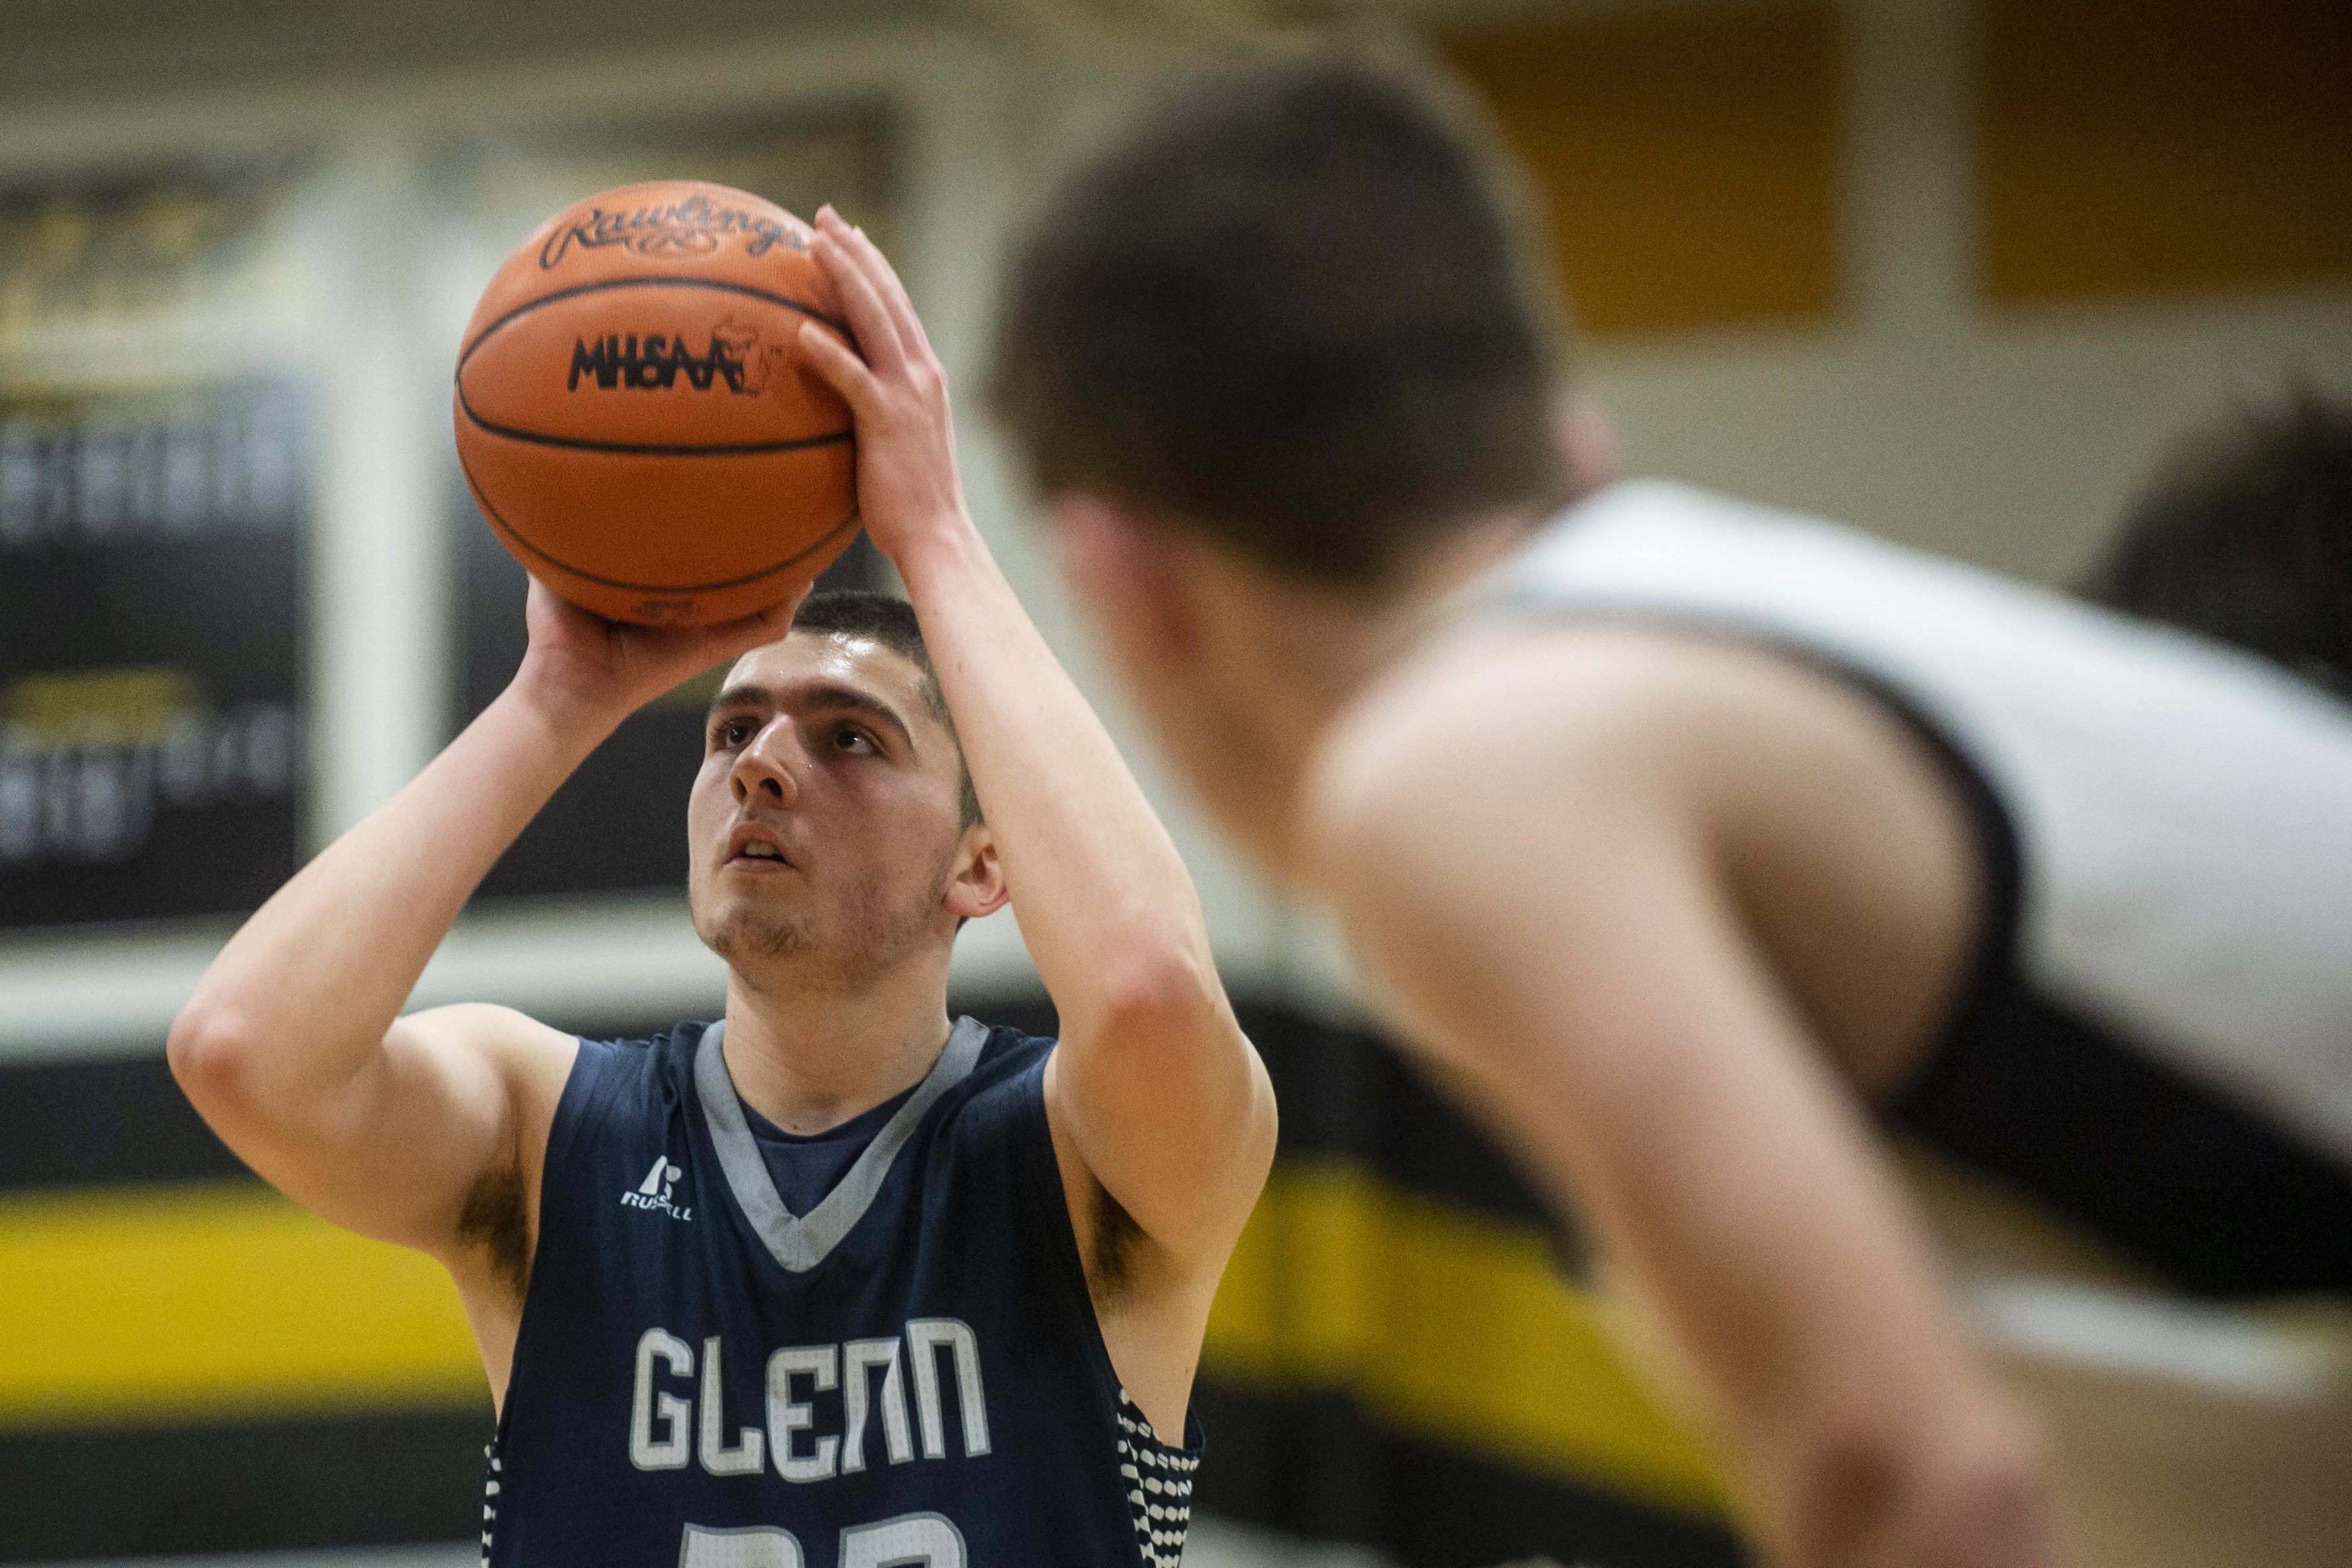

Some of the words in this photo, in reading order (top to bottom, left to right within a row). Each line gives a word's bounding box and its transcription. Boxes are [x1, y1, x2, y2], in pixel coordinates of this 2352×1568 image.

[539, 196, 810, 270] Rawlings
[567, 334, 745, 394] MHSAA
[629, 1317, 991, 1484] GLENN
